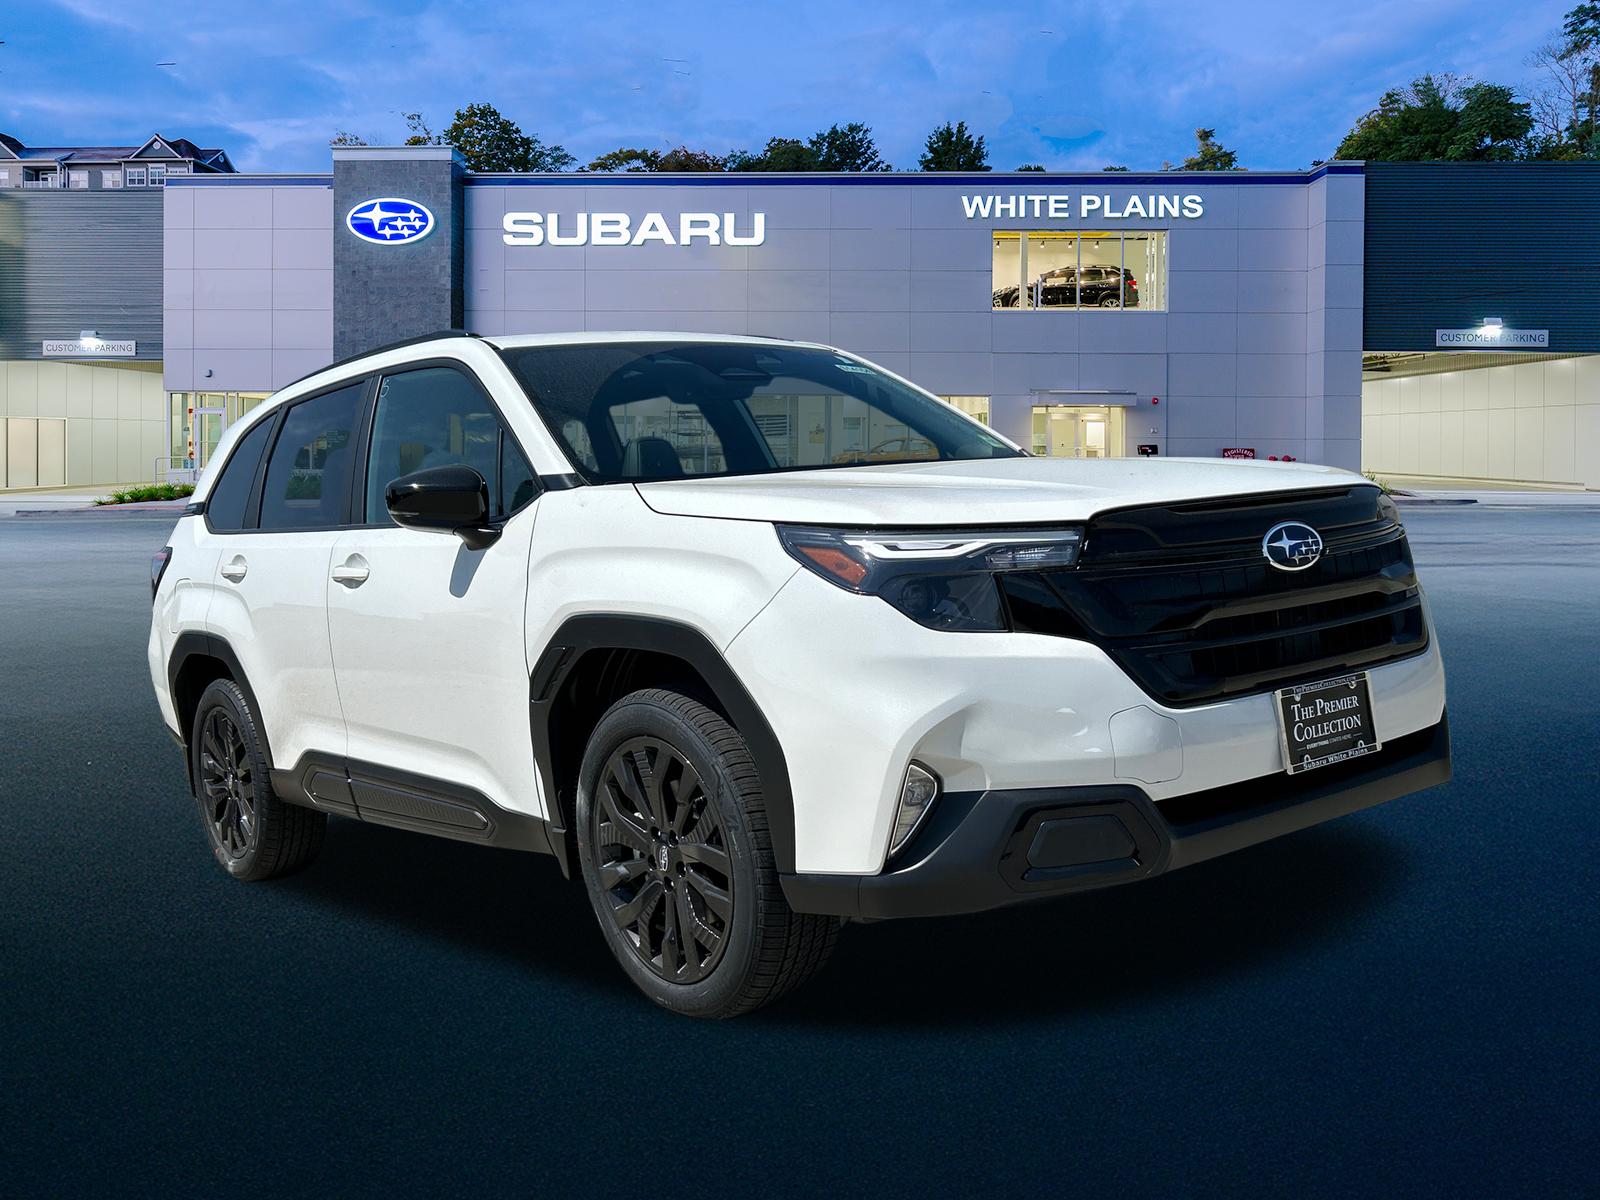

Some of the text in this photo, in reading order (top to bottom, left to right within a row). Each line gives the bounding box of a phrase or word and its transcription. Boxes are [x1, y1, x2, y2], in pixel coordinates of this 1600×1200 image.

[961, 195, 1204, 218] WHITE PLAINS
[502, 212, 765, 246] SUBARU
[95, 344, 132, 352] PARKING
[1440, 333, 1545, 343] CUSTOMER PARKING
[1291, 695, 1359, 722] THE PREMIER
[1293, 714, 1362, 742] COLLECTION
[1303, 759, 1327, 769] Subaru
[1328, 753, 1347, 763] White
